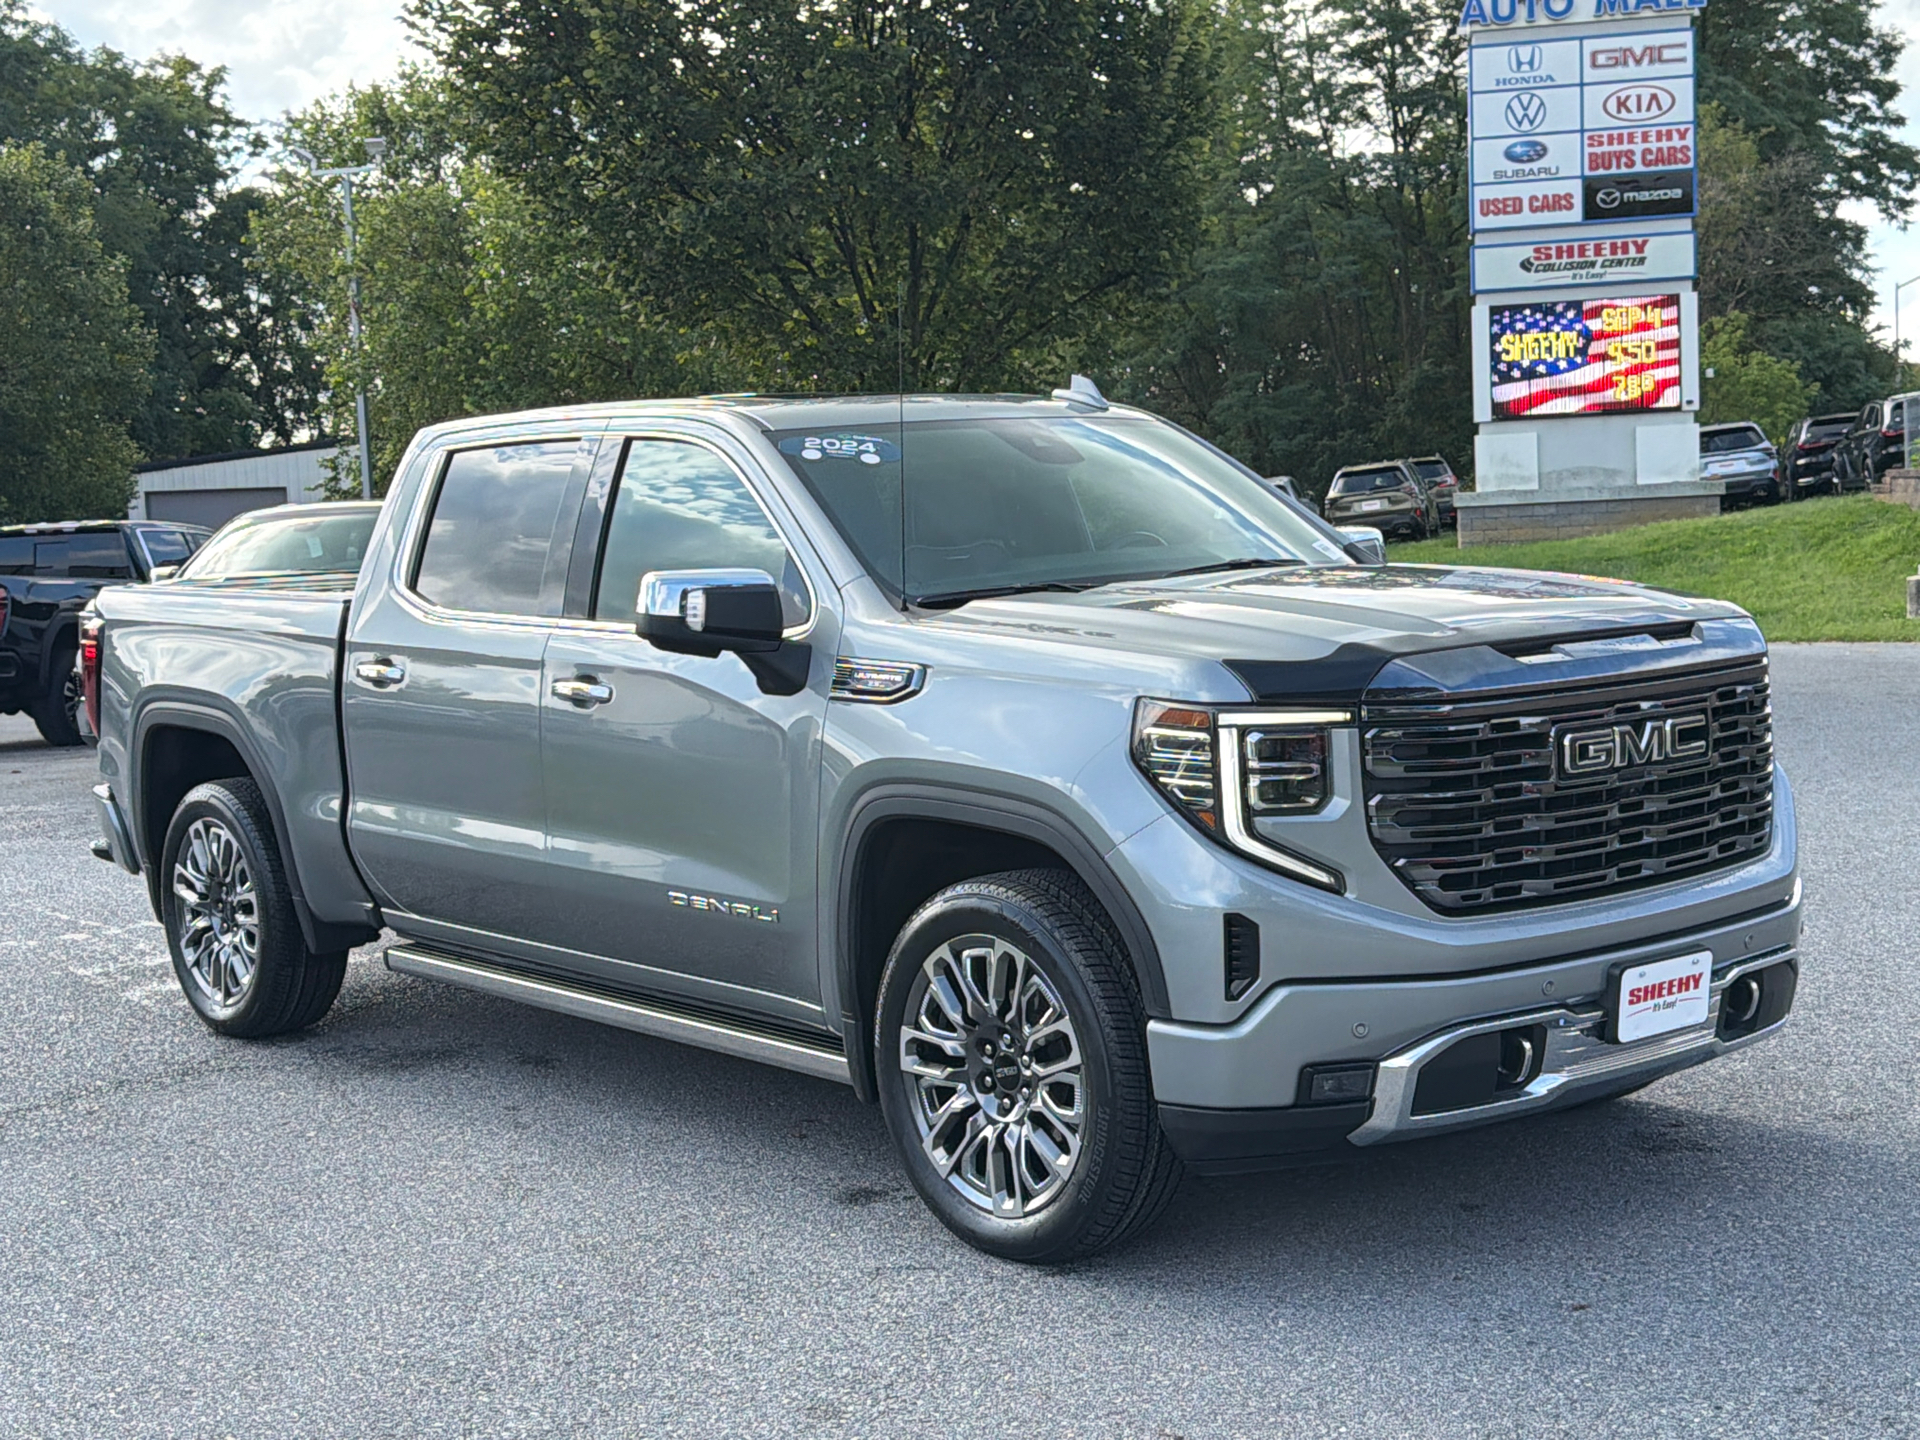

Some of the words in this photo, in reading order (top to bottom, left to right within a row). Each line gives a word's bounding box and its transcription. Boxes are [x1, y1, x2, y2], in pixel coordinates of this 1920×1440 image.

[1590, 43, 1687, 70] GMC
[1494, 74, 1556, 87] HONDA
[1615, 94, 1664, 115] KIA
[1587, 127, 1690, 148] SHEEHY
[1588, 149, 1636, 172] BUYS
[1641, 144, 1691, 168] CARS
[1493, 166, 1560, 180] SUBARU
[1479, 196, 1524, 217] USED
[1528, 192, 1574, 214] CARS
[1532, 239, 1650, 262] SHEEHY
[1533, 259, 1598, 274] COLLISION
[1600, 256, 1647, 269] CENTER
[1602, 306, 1642, 332] SEP
[1646, 305, 1662, 329] 4
[1500, 330, 1578, 362] SHEEHY
[804, 437, 876, 453] 2024
[1563, 714, 1706, 774] GMC
[668, 890, 779, 923] DENALI
[1628, 971, 1704, 1006] SHEEHY
